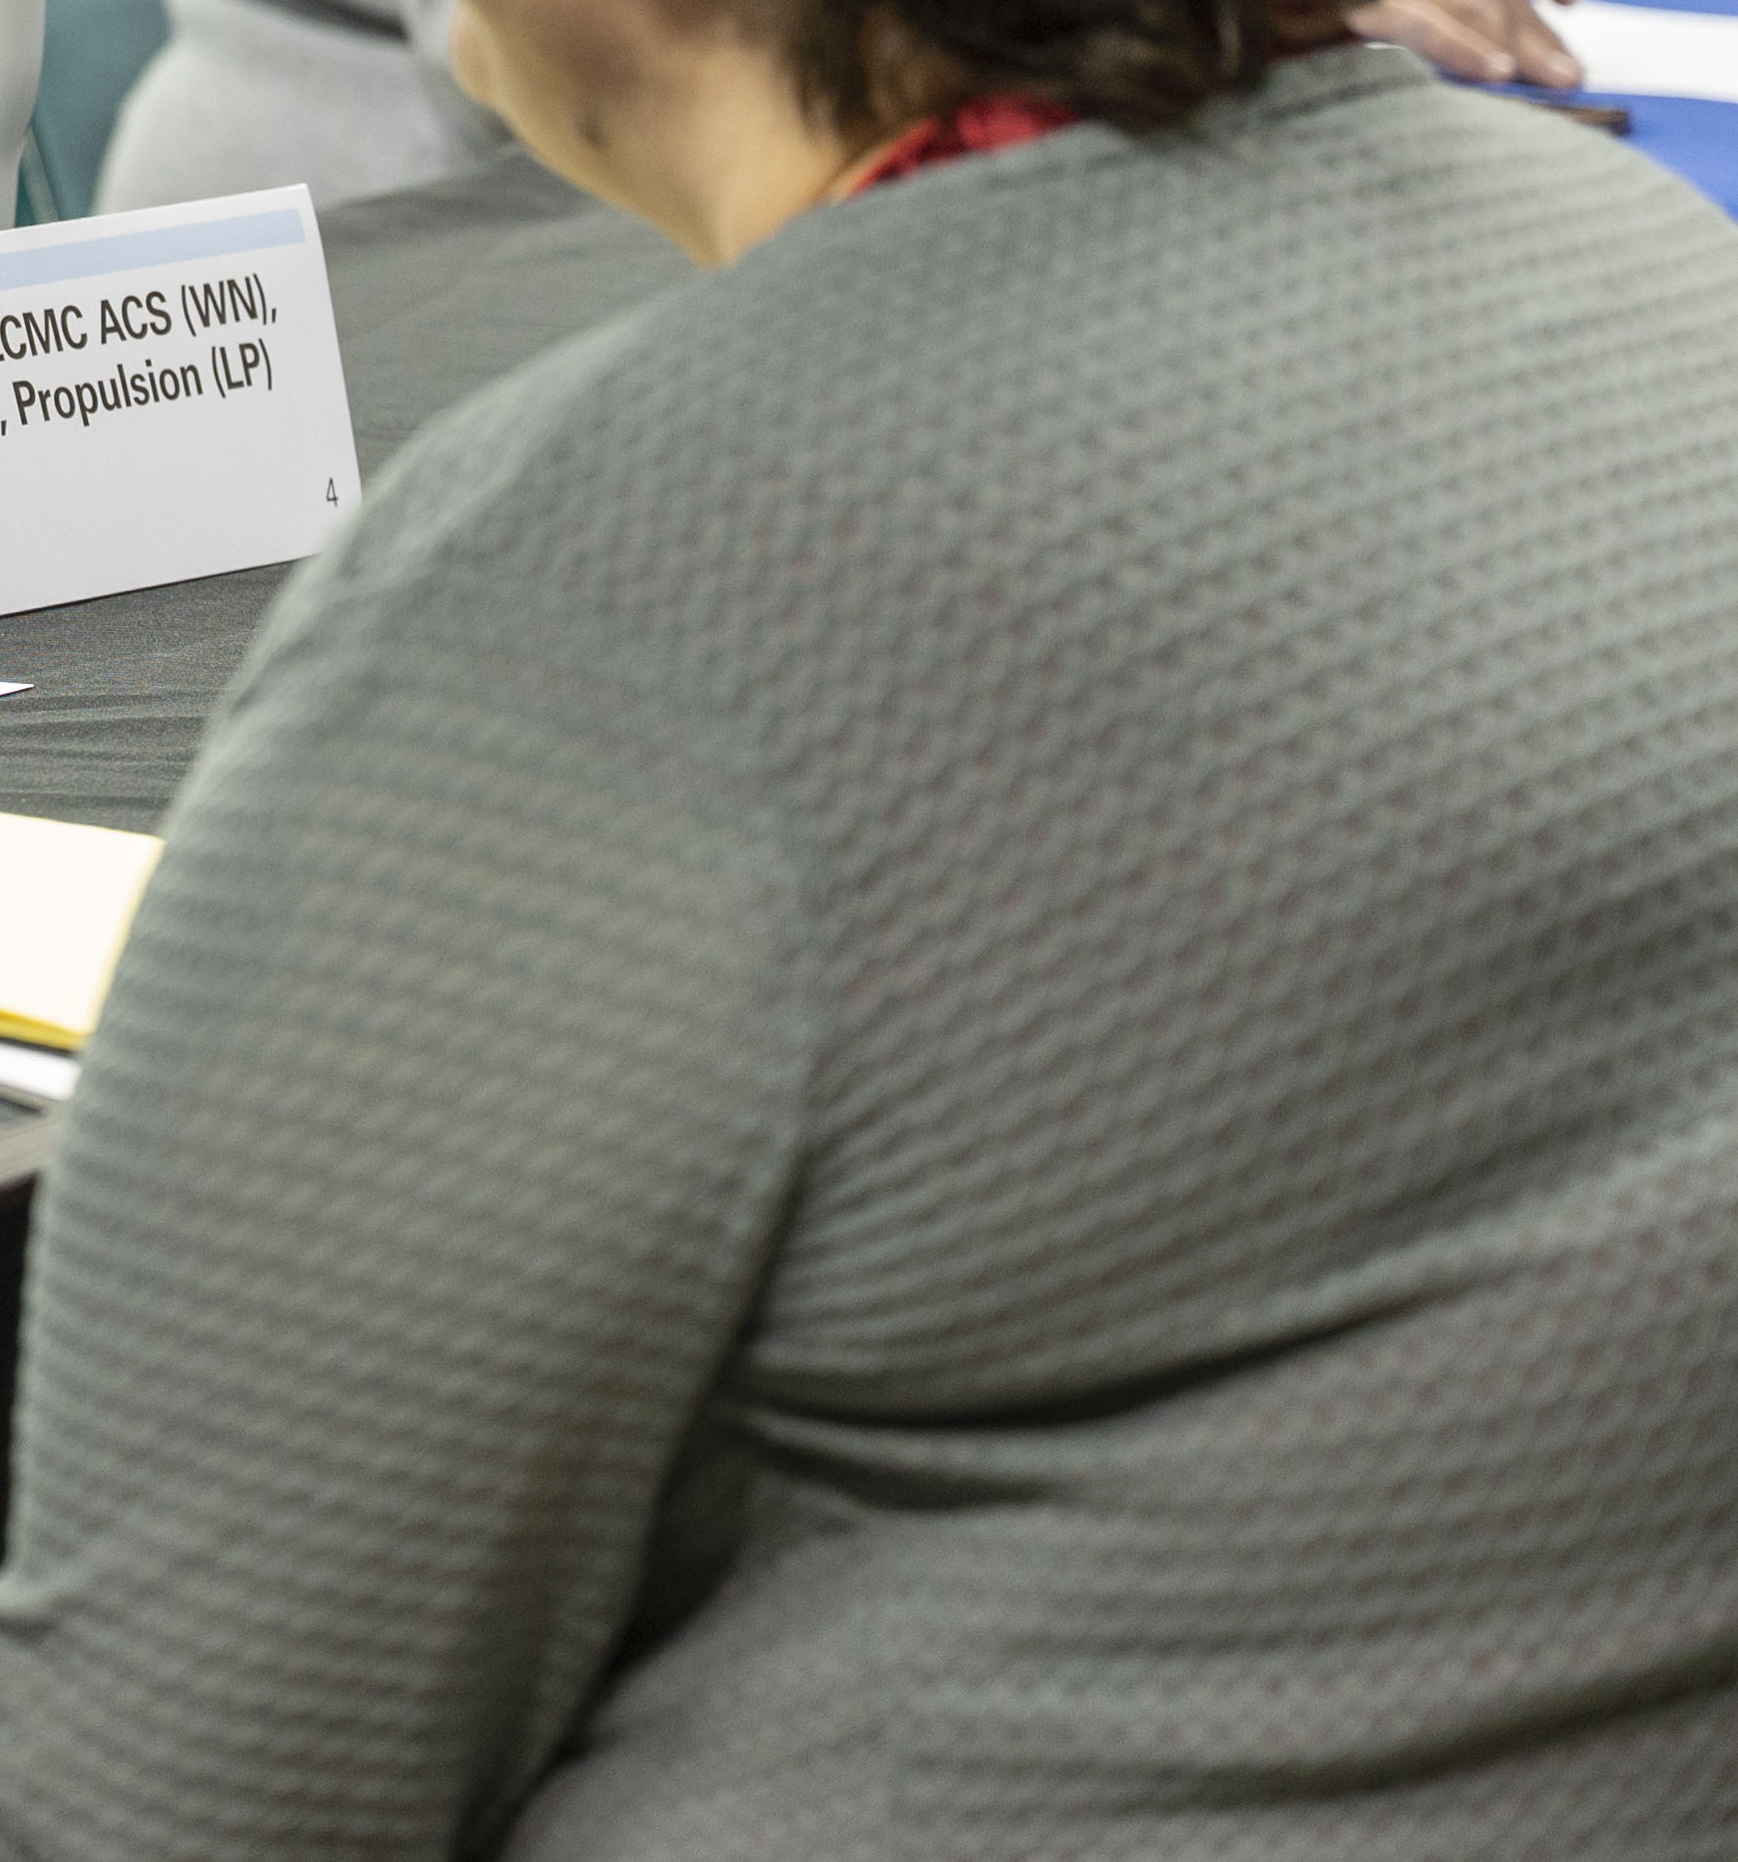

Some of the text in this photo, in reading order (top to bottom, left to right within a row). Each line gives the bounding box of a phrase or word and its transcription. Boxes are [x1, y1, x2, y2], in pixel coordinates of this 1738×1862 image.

[100, 290, 173, 345] ACS
[181, 273, 278, 337] (WN),
[12, 359, 204, 427] Propulsion
[212, 338, 273, 398] (LP)
[324, 476, 340, 508] 4
